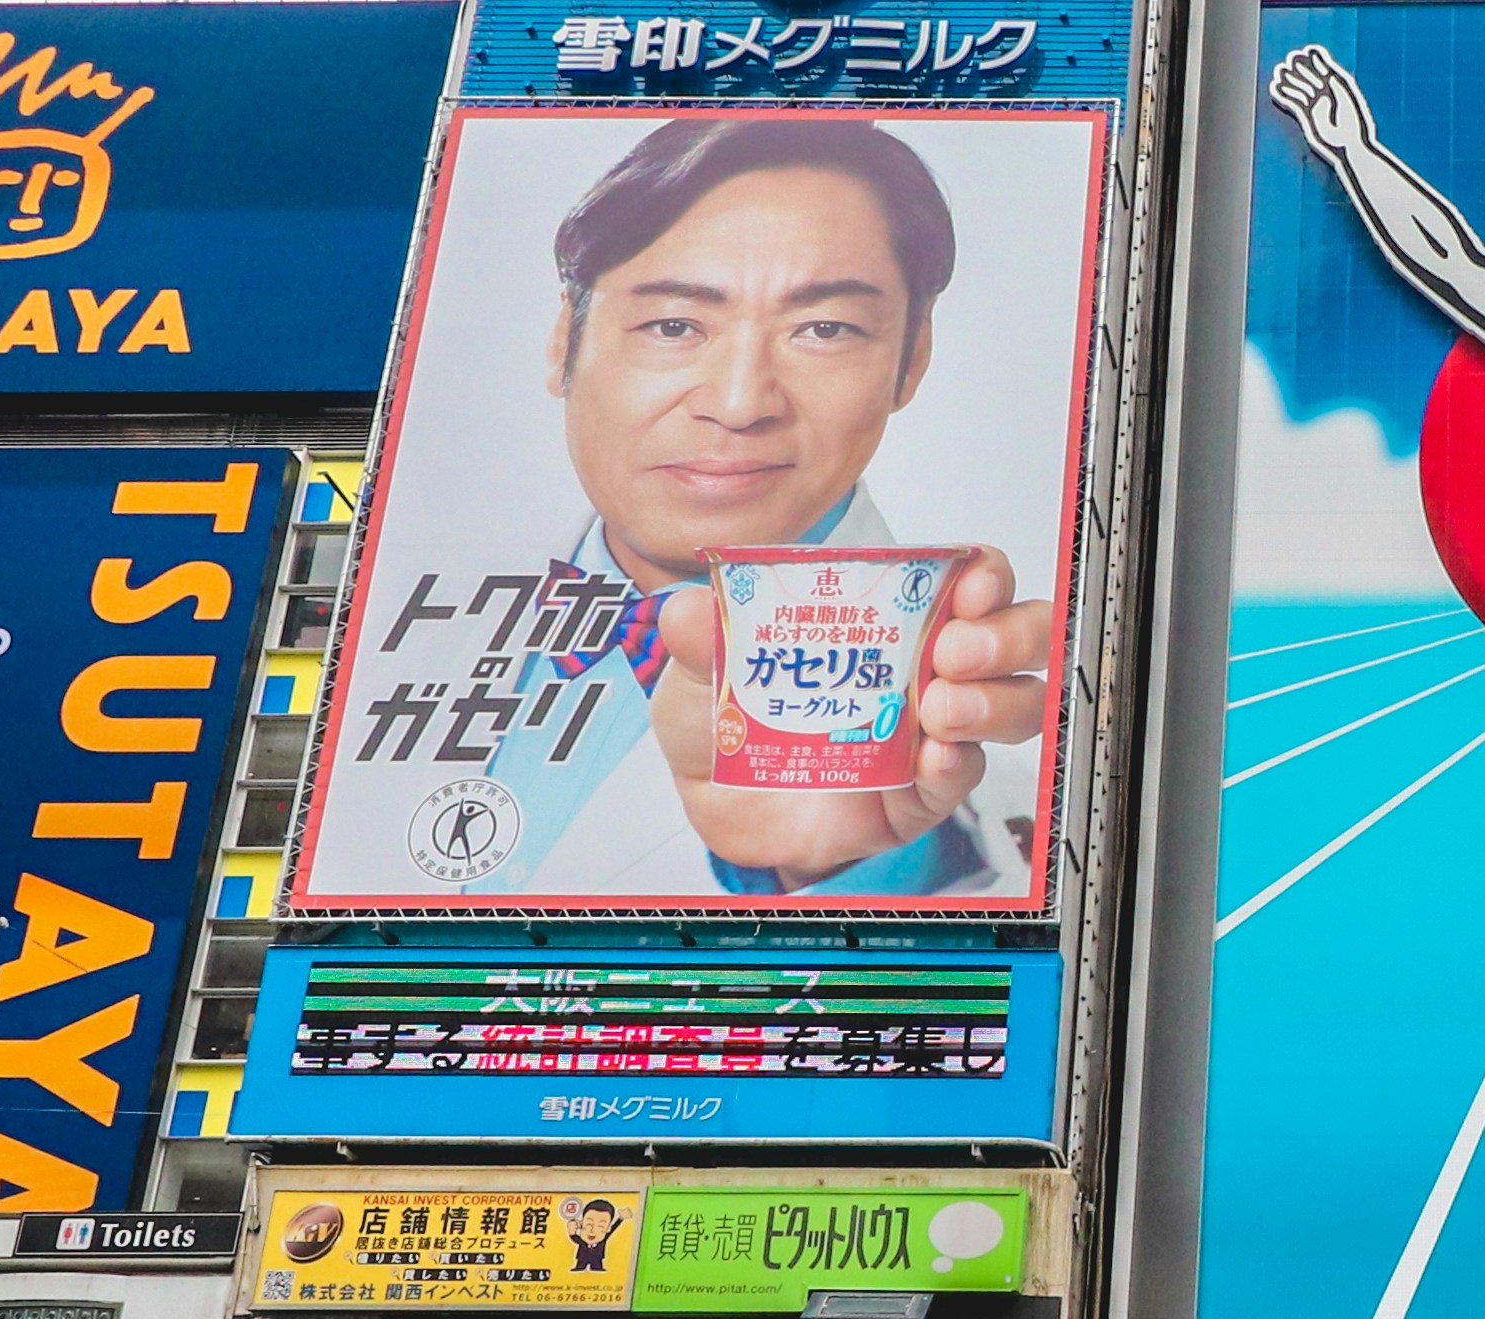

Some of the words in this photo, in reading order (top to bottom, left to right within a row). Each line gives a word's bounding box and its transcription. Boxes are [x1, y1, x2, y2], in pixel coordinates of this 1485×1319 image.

[552, 14, 1039, 76] 雪印メグミルク
[809, 566, 850, 598] 恵
[378, 573, 630, 654] トクホ
[774, 605, 880, 625] 内臓脂肪を
[754, 625, 902, 645] 減らすのを助ける
[469, 656, 514, 679] の
[742, 646, 858, 691] ガセリ
[767, 696, 863, 719] ヨーグルト
[354, 682, 608, 763] ガセリ
[753, 769, 814, 784] はっ酵乳
[818, 770, 861, 785] 100g
[538, 1096, 723, 1123] 雪印メグミルク
[362, 1194, 411, 1206] KANSAI
[412, 1194, 460, 1206] INVEST
[462, 1194, 553, 1207] CORPORATION
[358, 1206, 552, 1236] 店舗情報館
[99, 1219, 198, 1252] Toilets
[354, 1235, 547, 1251] 居抜き店舗総合プロデュース
[656, 1211, 758, 1263] 賃貸・売買
[762, 1202, 913, 1272] ピタットハウス
[298, 1282, 377, 1302] 株式会社
[384, 1282, 505, 1302] 関西インベスト
[510, 1292, 533, 1302] TEL
[646, 1282, 783, 1296] http://www.pitat.com/
